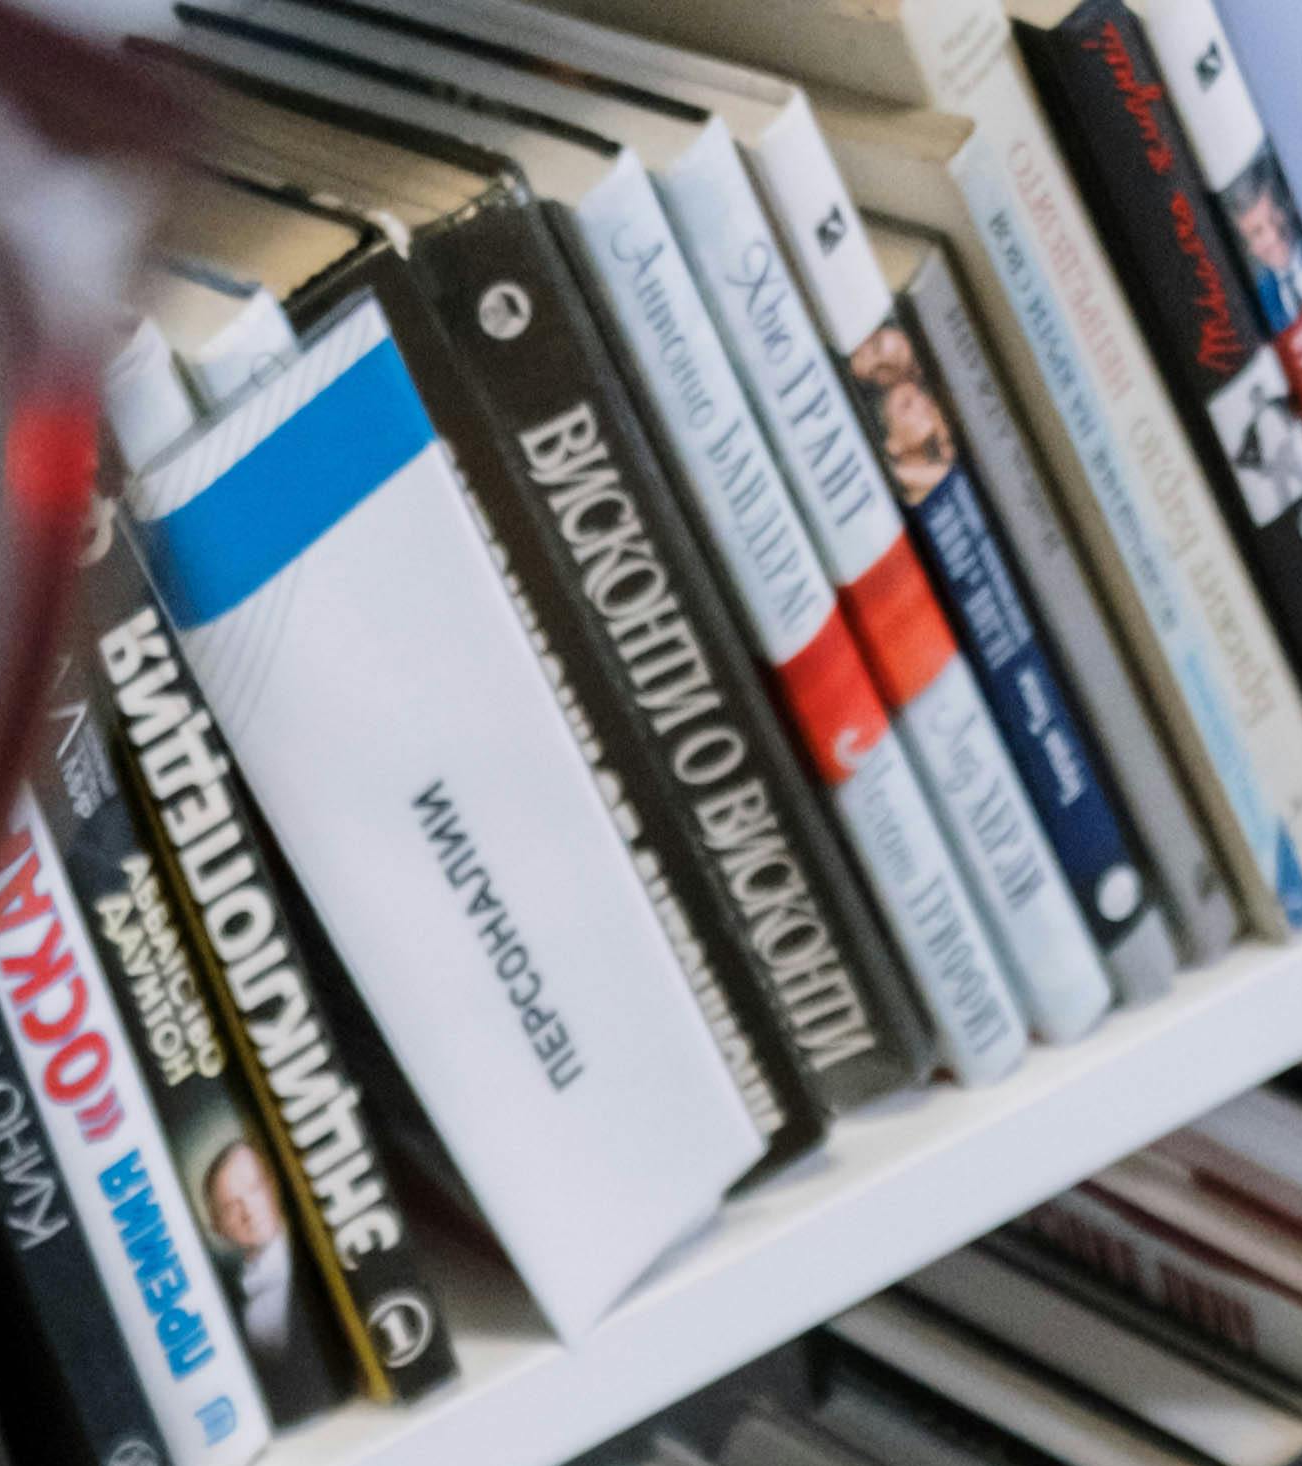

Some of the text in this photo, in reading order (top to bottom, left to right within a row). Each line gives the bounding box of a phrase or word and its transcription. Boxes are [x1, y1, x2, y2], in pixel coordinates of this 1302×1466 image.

[616, 216, 714, 430] Антонио
[774, 352, 881, 529] ГРАНТ
[524, 404, 696, 751] ВИСКОНТИ
[677, 716, 740, 784] О
[96, 898, 200, 1087] ДАУНТОН
[99, 608, 397, 1273] ЭНЦИКЛОПЕДИЯ
[119, 855, 222, 1077] АББАТСТВО
[410, 776, 583, 1094] ПЕРСОНАЛИИ
[697, 770, 878, 1073] ВИСКОНТИ
[97, 1148, 216, 1381] ПРЕМИЯ
